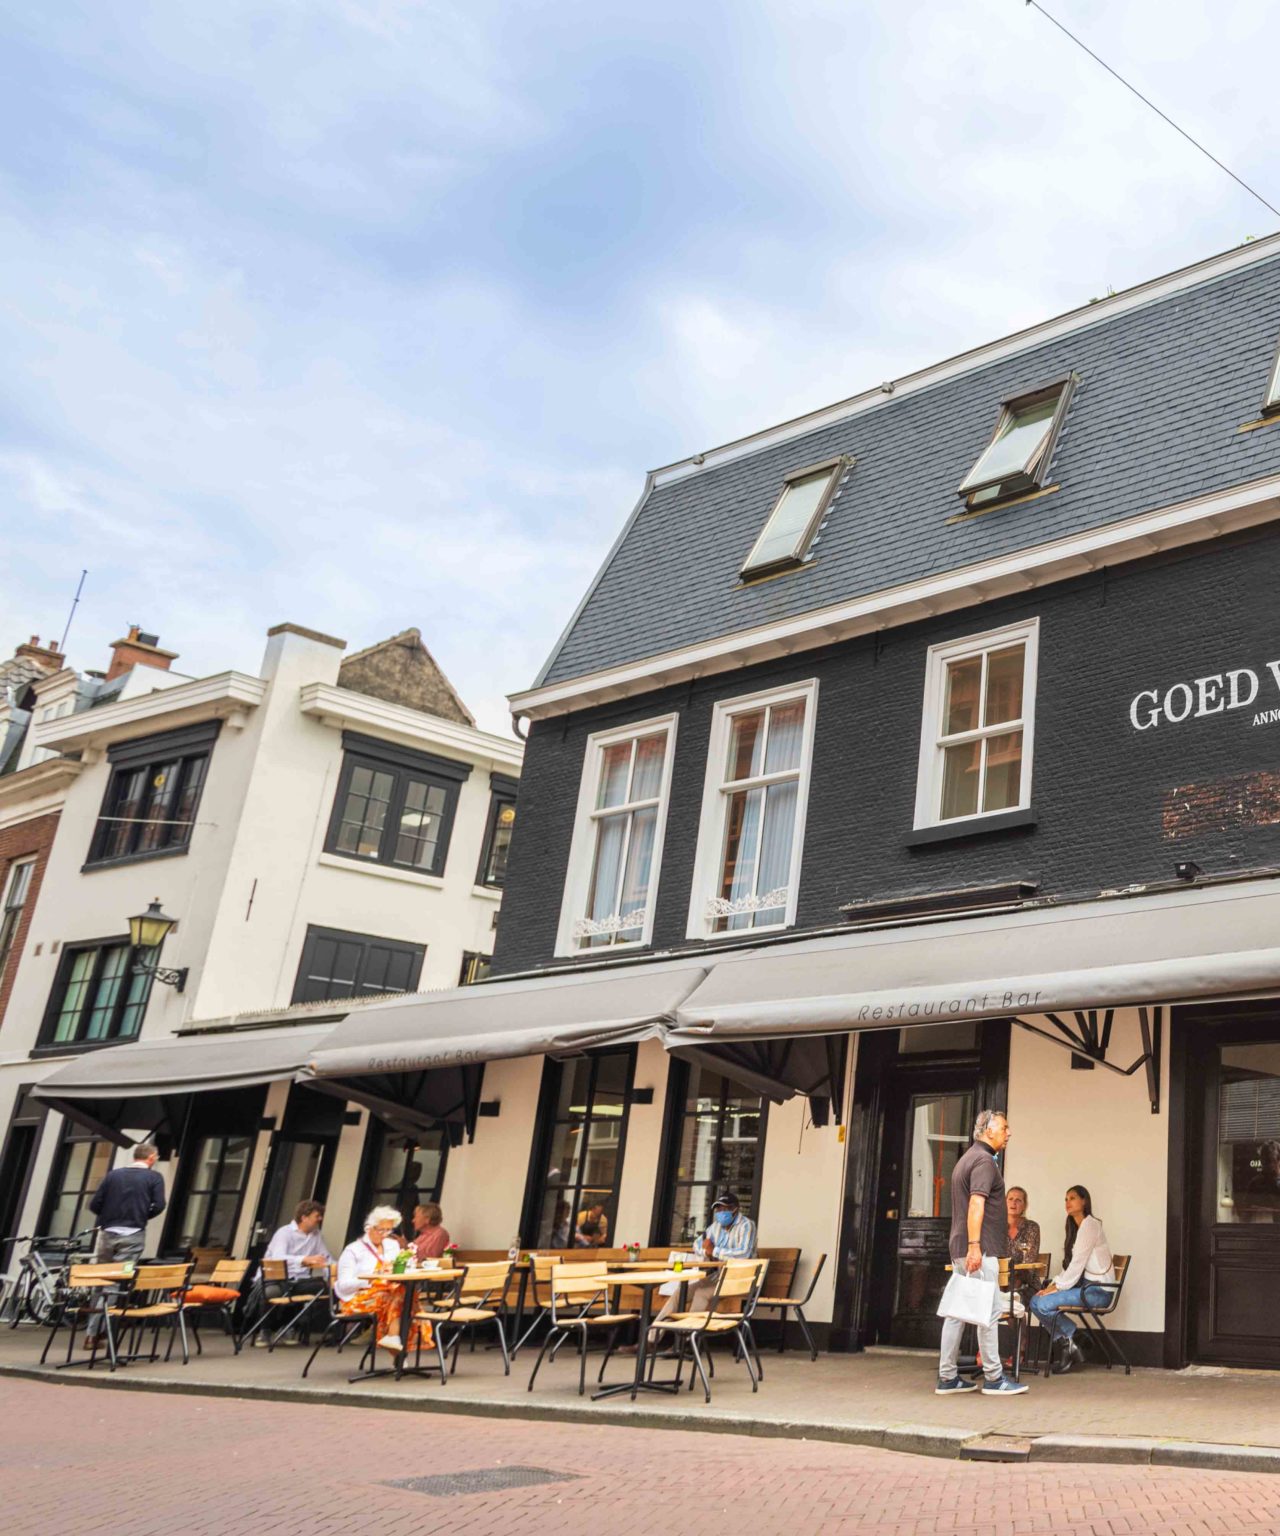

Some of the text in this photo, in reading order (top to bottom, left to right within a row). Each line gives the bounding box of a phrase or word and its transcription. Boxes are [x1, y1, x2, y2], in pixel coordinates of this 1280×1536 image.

[1130, 669, 1259, 730] GOED
[858, 990, 1042, 1021] Restaurant Bar
